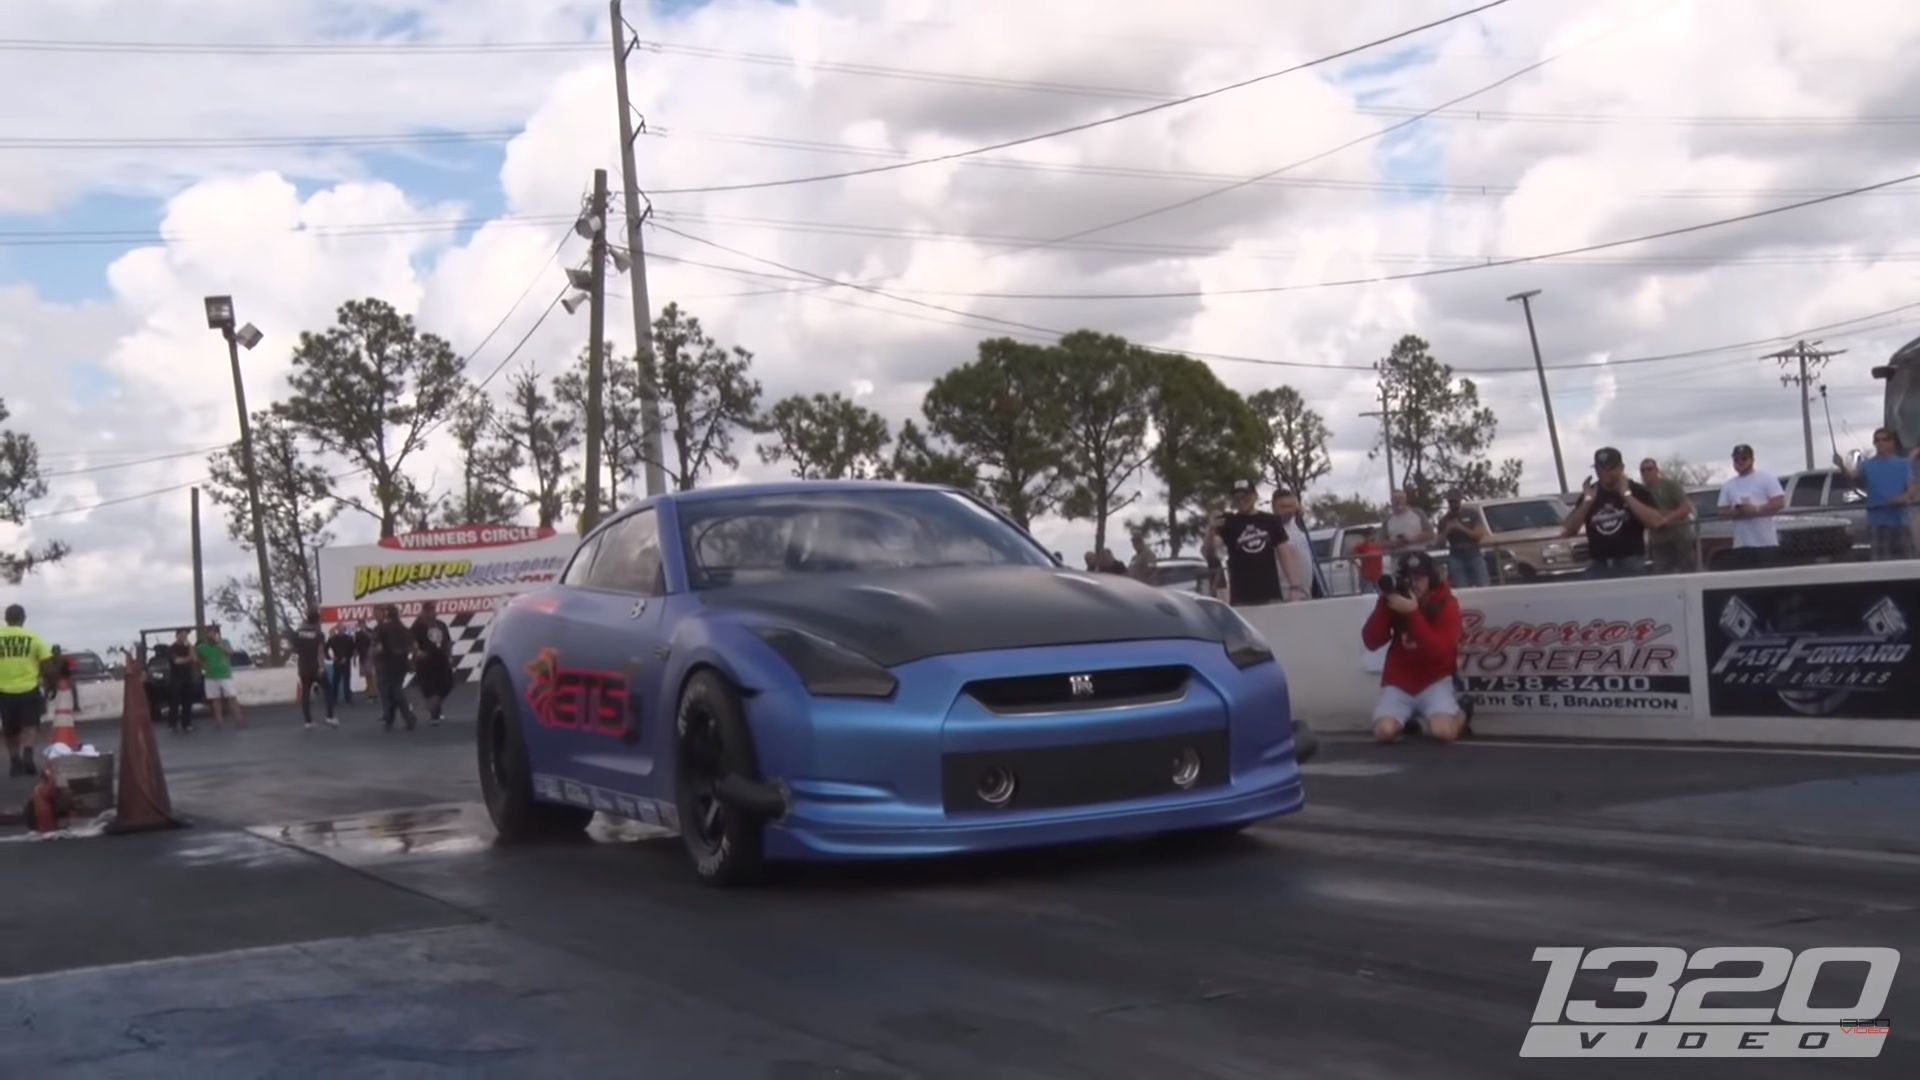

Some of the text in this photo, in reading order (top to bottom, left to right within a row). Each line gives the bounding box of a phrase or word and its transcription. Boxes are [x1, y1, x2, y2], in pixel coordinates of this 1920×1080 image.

[400, 526, 538, 549] WINNERS CIRCLE
[1460, 609, 1672, 654] Superior
[1460, 647, 1678, 674] TO REPAIR
[1723, 670, 1892, 685] RACE ENGINES
[1563, 694, 1678, 710] BRADENTON
